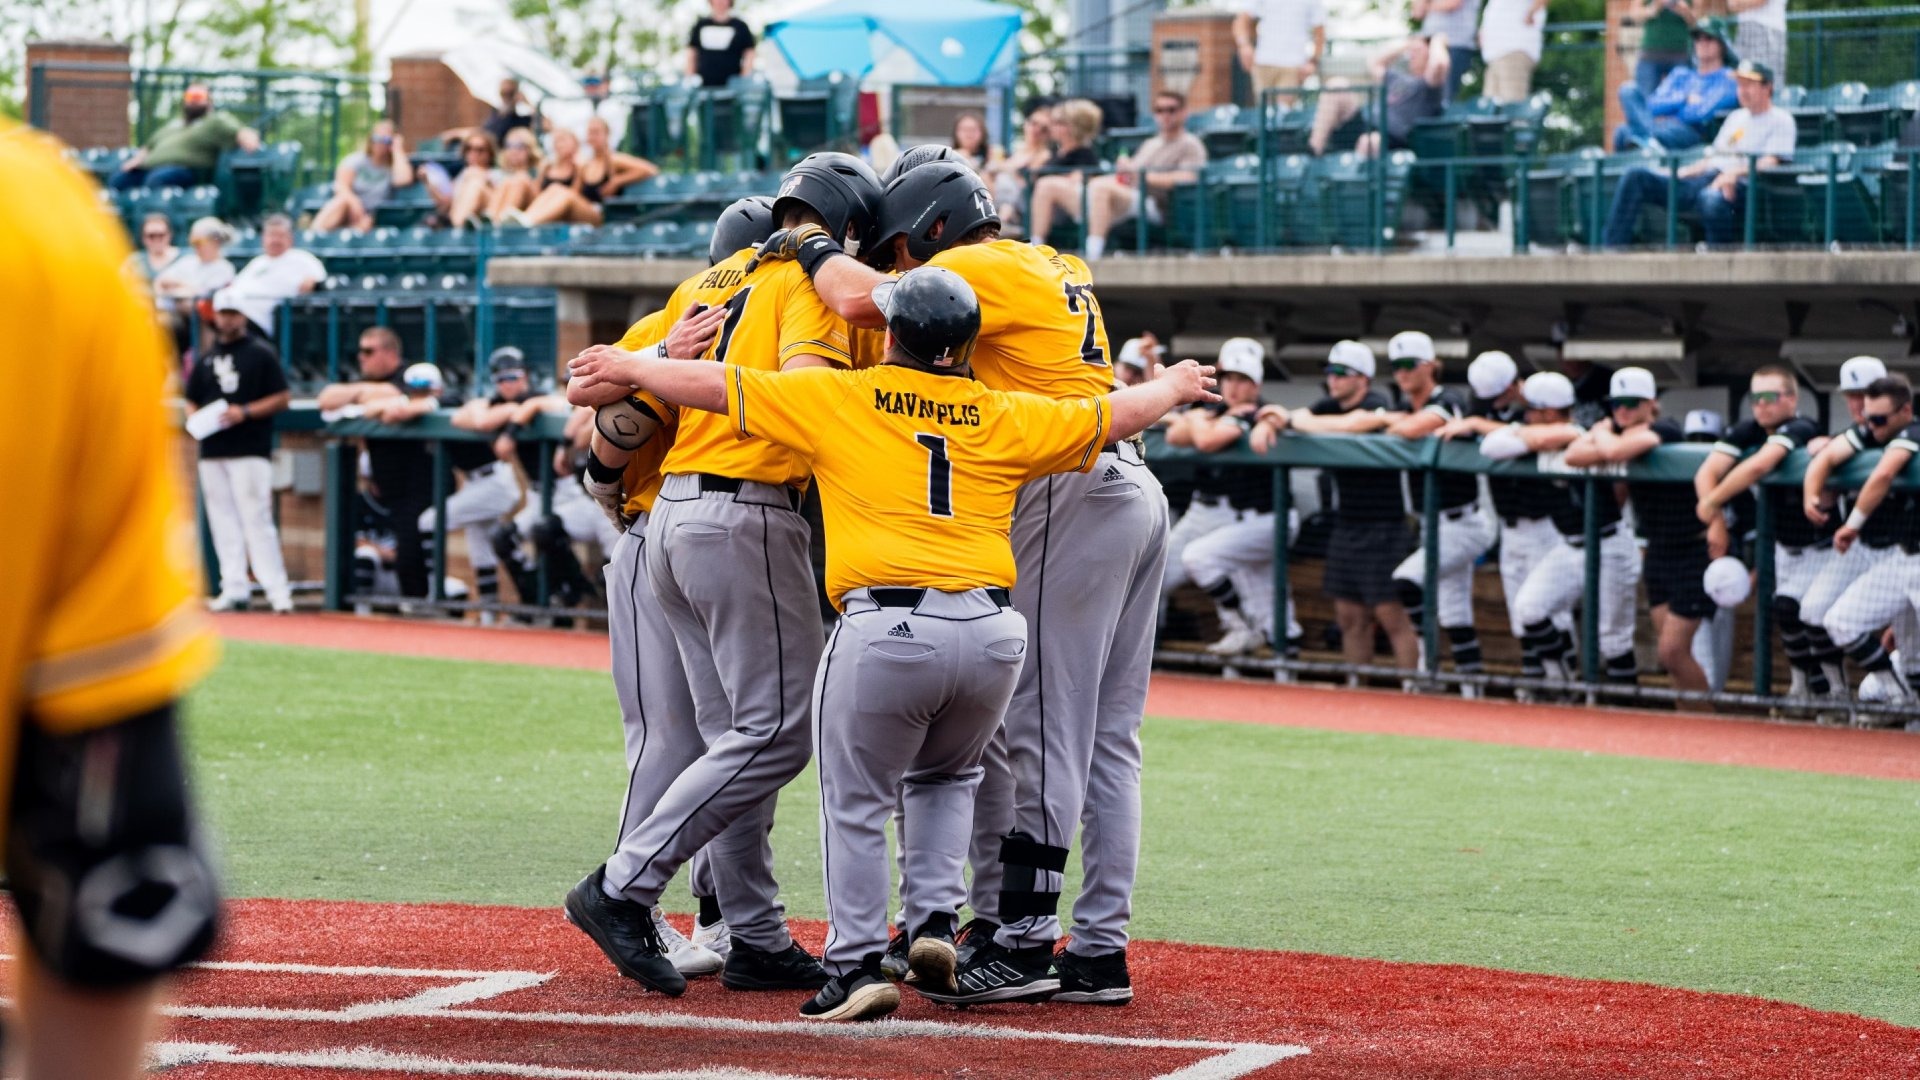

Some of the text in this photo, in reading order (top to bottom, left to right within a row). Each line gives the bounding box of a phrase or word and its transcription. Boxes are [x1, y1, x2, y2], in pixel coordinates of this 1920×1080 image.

[1064, 281, 1108, 368] 2
[914, 431, 954, 518] 1
[888, 629, 914, 639] adidas
